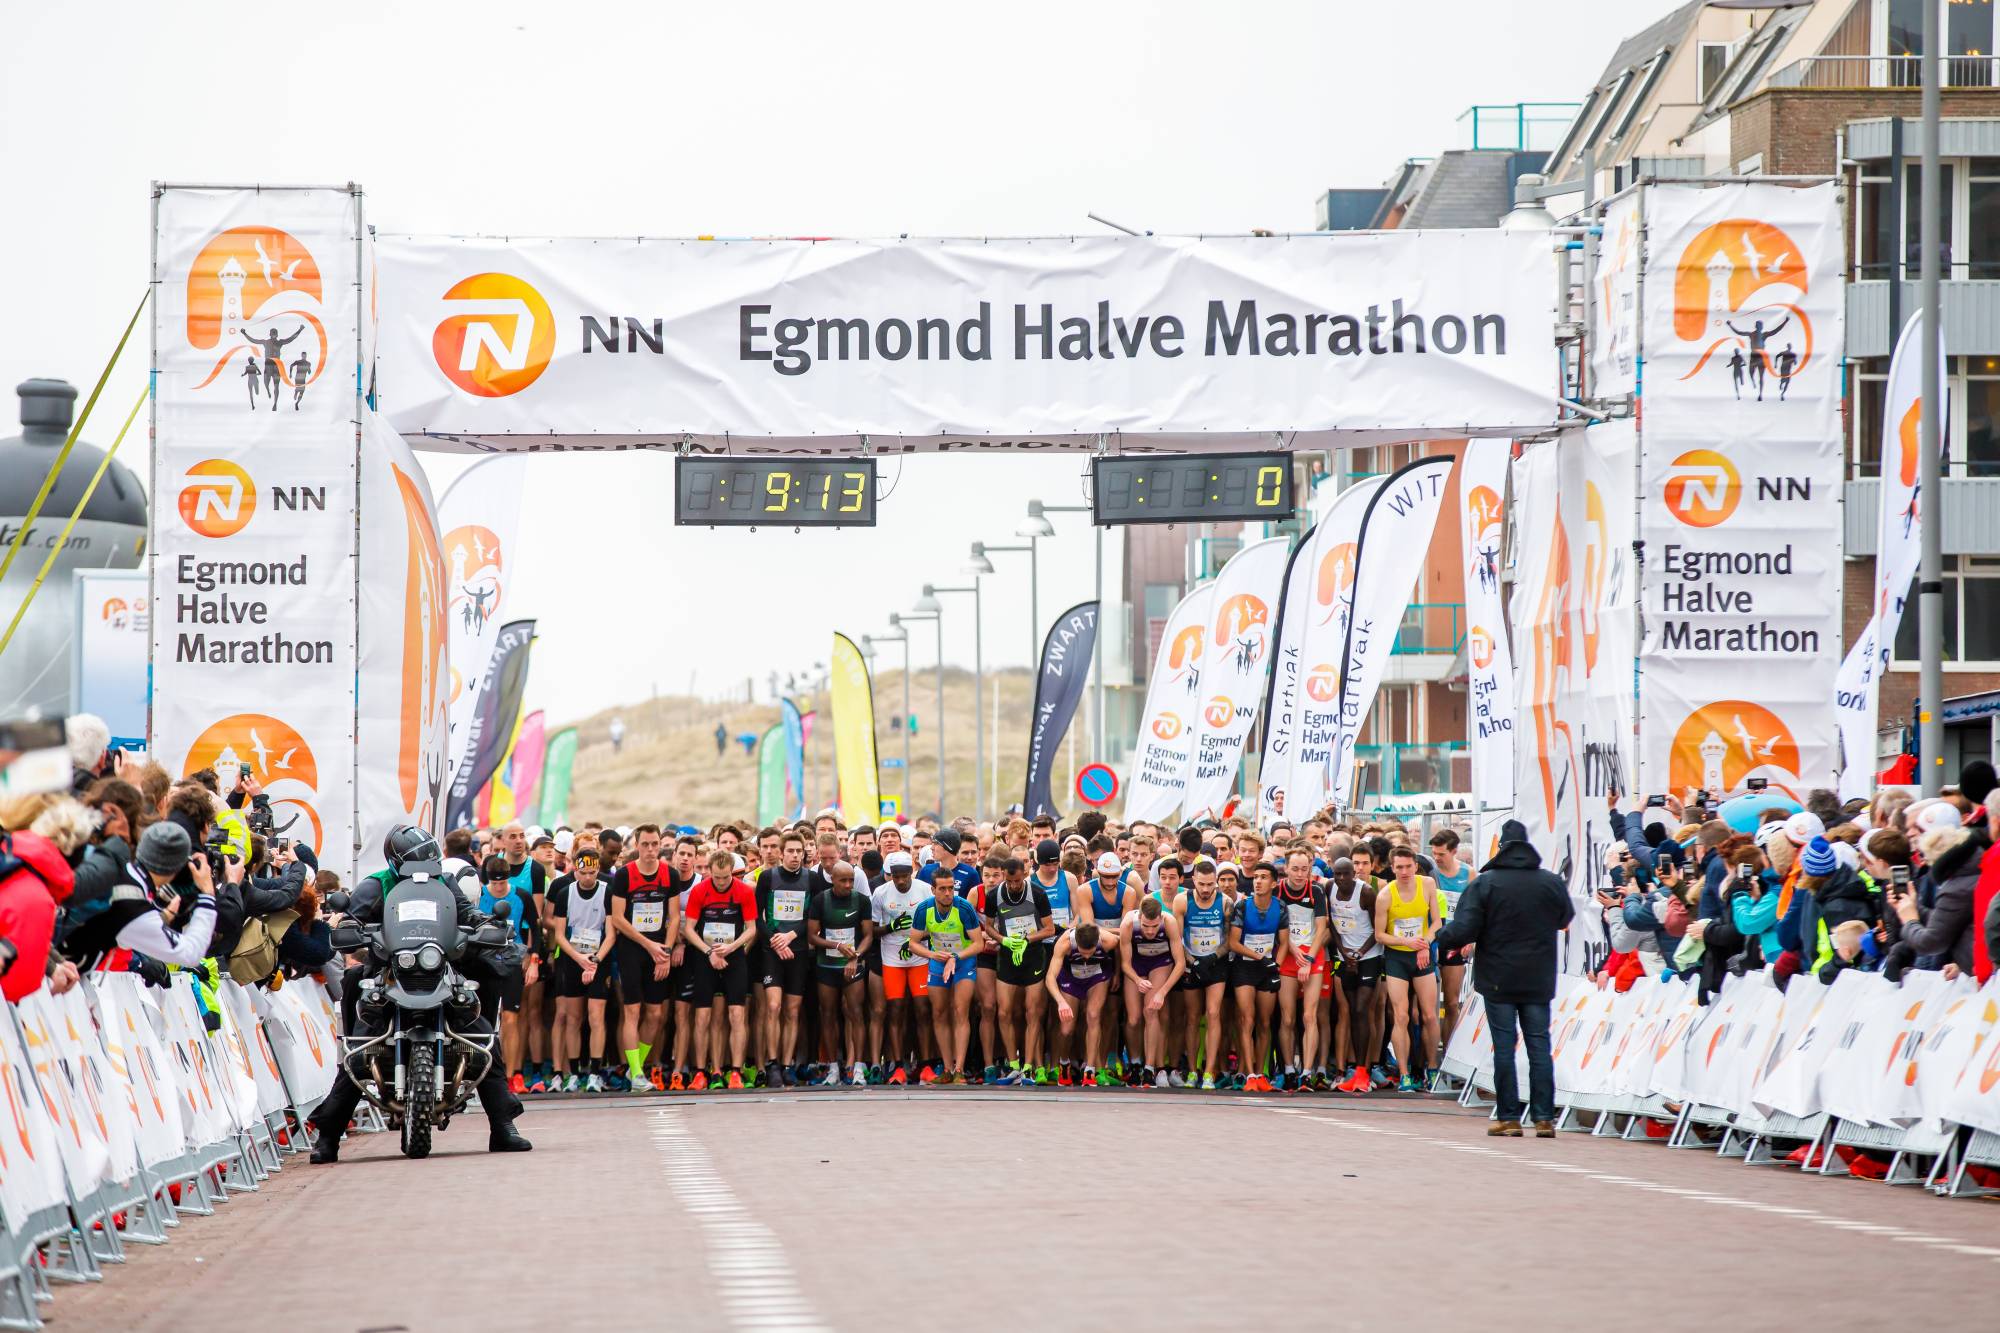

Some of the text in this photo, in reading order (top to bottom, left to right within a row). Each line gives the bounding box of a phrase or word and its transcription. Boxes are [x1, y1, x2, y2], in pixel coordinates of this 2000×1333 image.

[580, 299, 1506, 376] NN Egmond Halve Marathon
[271, 486, 326, 511] NN
[765, 472, 866, 512] 9:13
[1387, 473, 1442, 518] WIT
[1757, 477, 1811, 501] NN
[177, 554, 307, 592] Egmond
[1664, 544, 1792, 582] Egmond
[177, 592, 268, 624] Halve
[1663, 582, 1753, 613] Halve
[176, 632, 334, 664] Marathon
[1046, 611, 1095, 677] ZWART
[1662, 620, 1819, 652] Marathon
[1273, 643, 1299, 756] Startvak
[1146, 743, 1188, 762] Egmon
